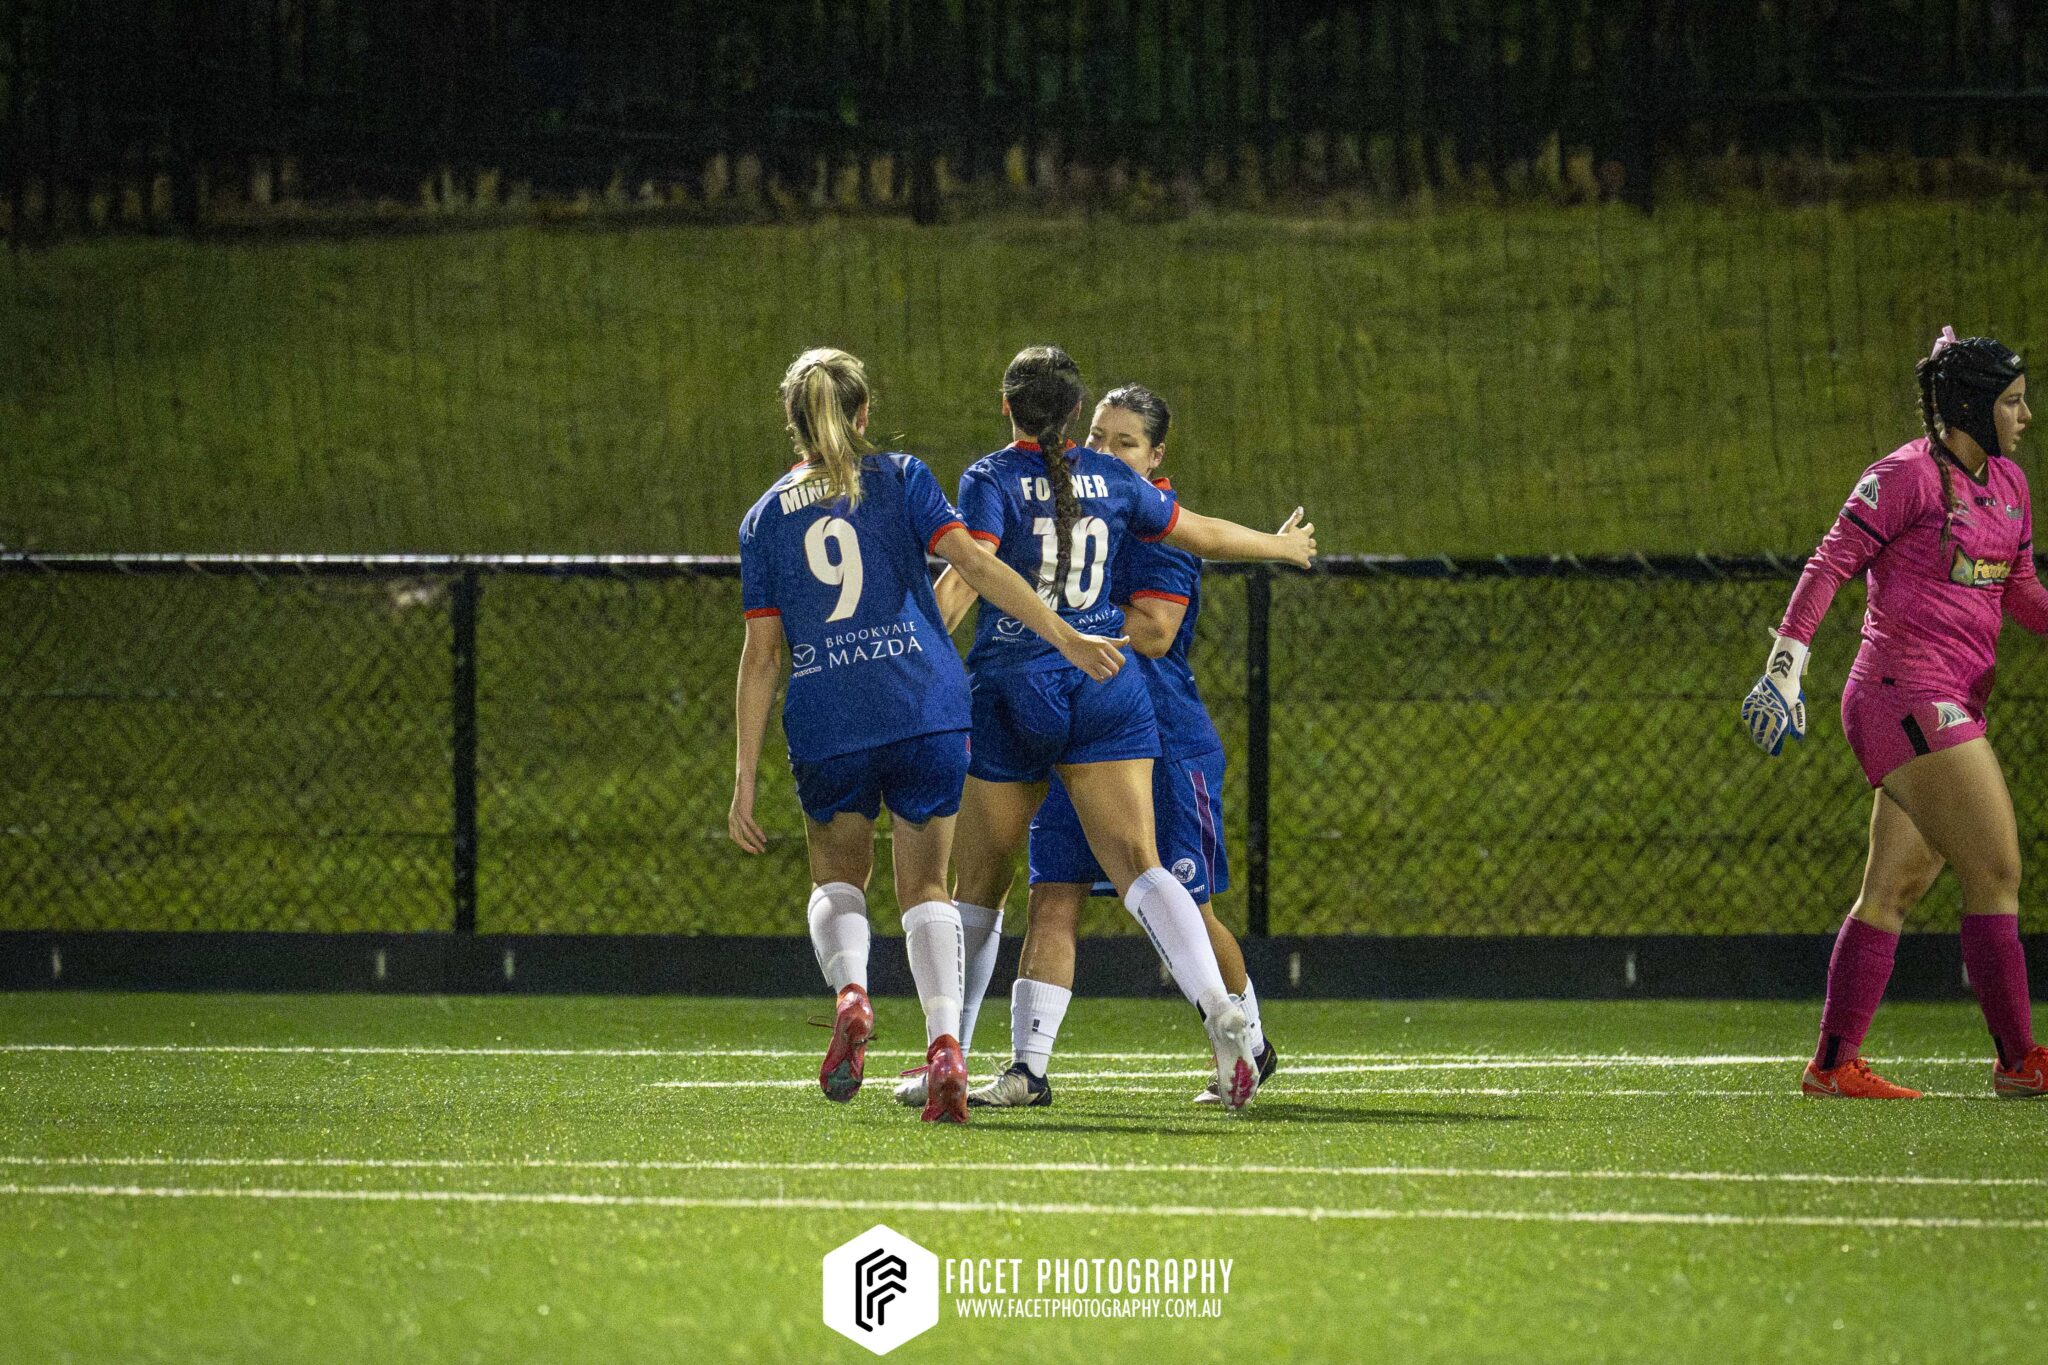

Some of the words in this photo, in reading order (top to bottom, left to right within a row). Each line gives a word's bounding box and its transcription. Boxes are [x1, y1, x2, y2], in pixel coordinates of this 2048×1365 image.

[1020, 474, 1109, 501] FONER
[804, 515, 863, 623] 9
[1033, 516, 1109, 611] 10
[825, 621, 917, 649] BROOKVALE
[828, 635, 923, 669] MAZDA
